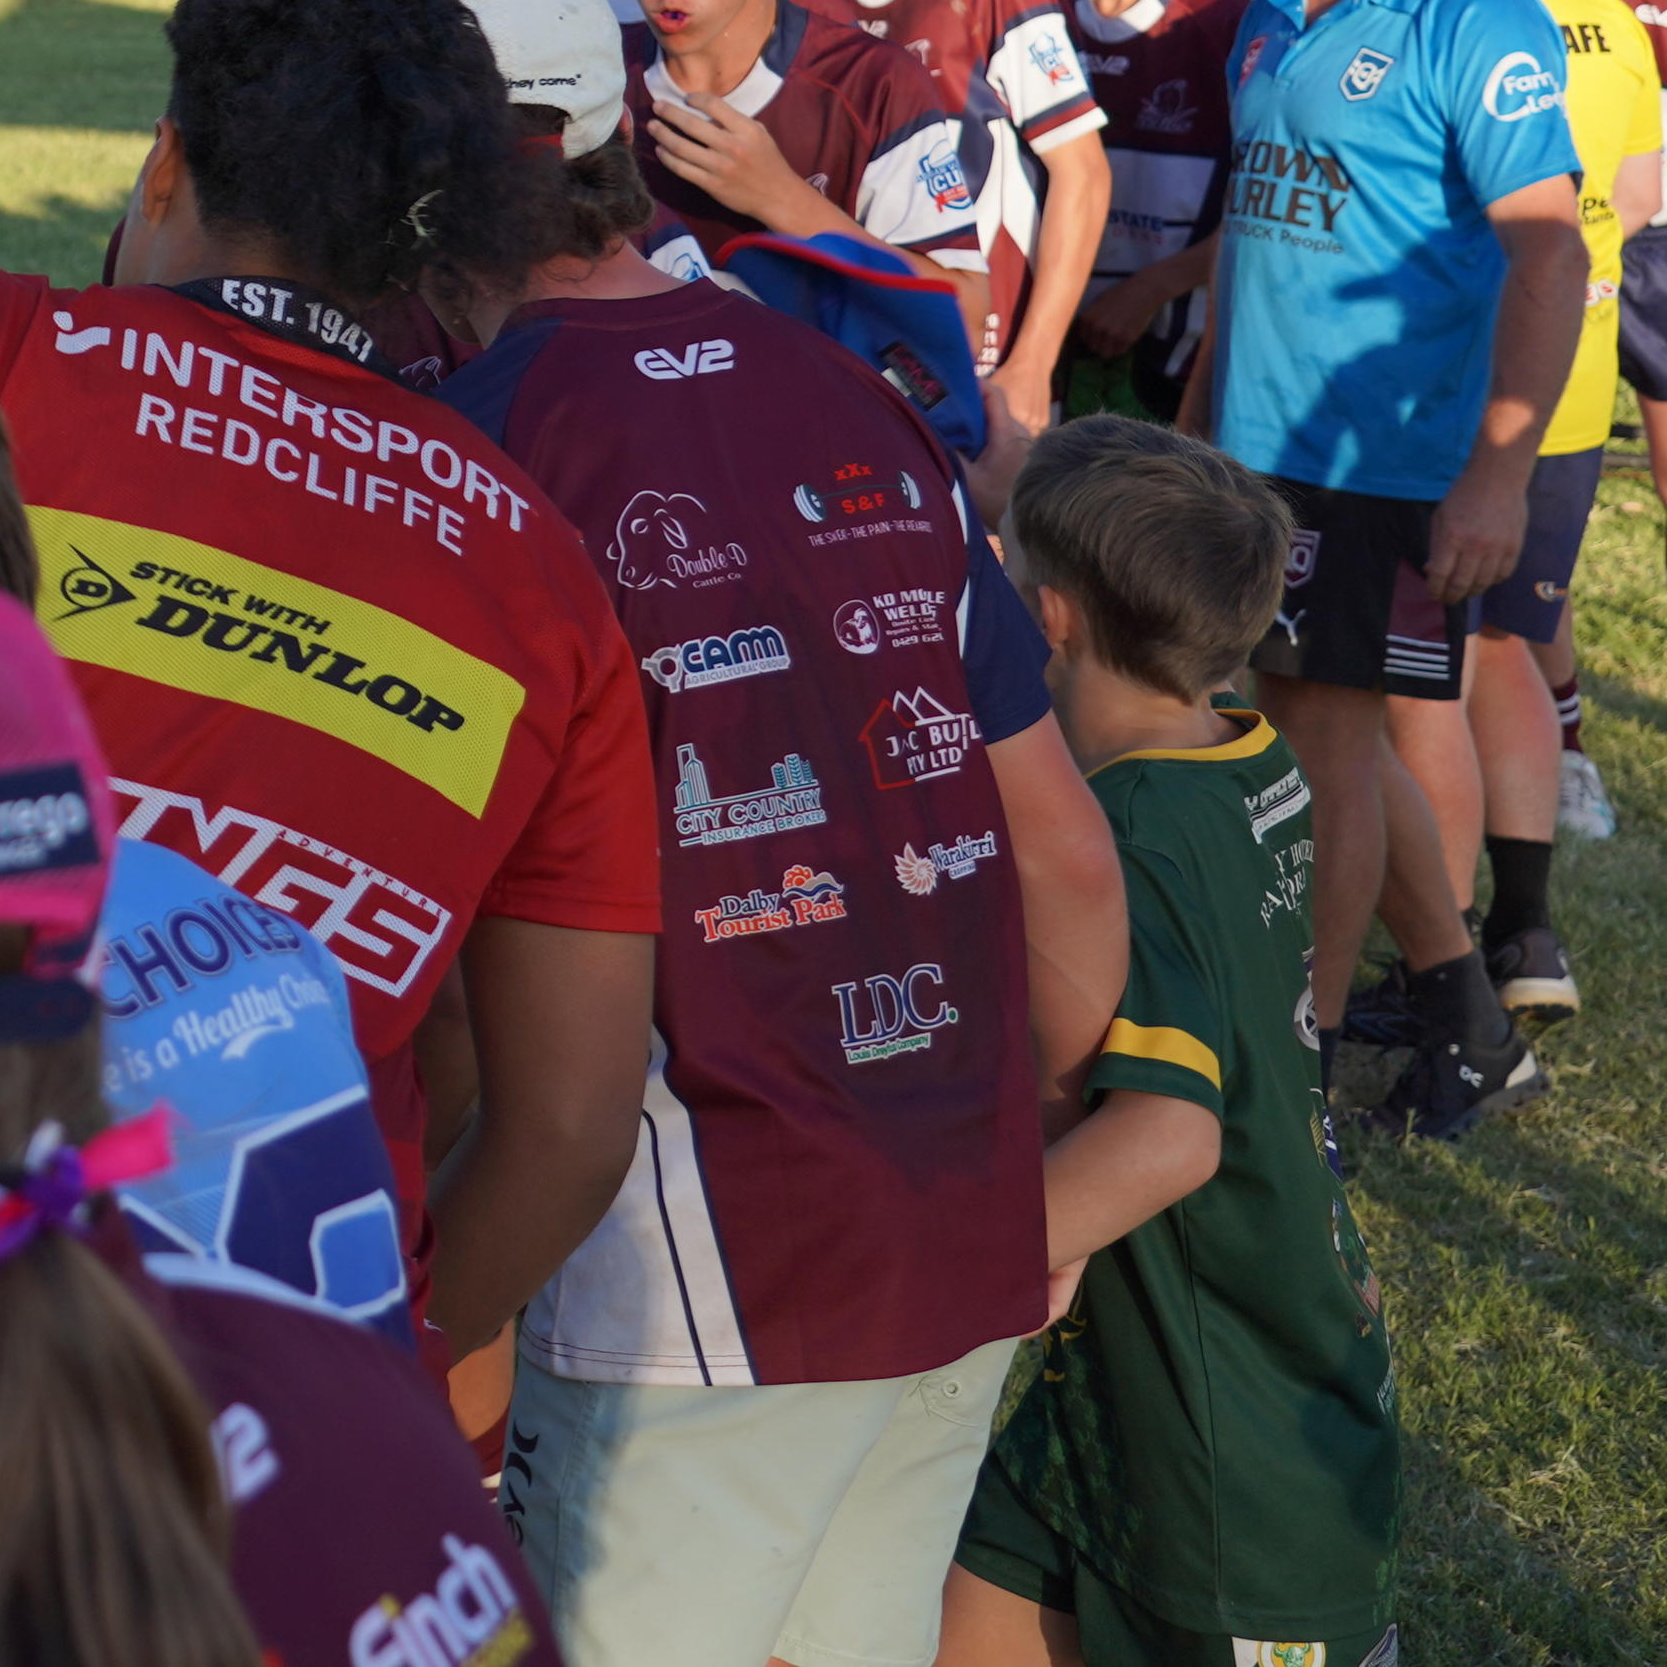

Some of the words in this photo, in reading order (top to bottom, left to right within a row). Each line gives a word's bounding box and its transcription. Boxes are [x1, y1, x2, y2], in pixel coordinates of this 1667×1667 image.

[507, 77, 535, 91] hey
[1278, 229, 1347, 255] People
[220, 277, 295, 325] EST.
[121, 327, 530, 533] INTERSPORT
[134, 392, 466, 557] REDCLIFFE
[667, 546, 729, 578] Double
[726, 542, 748, 566] D
[129, 561, 239, 606] STICK
[242, 593, 331, 635] WITH
[872, 593, 896, 608] KD
[134, 593, 465, 733] DUNLOP
[685, 663, 758, 687] AGRICULTURAL
[758, 657, 790, 671] GROUP
[929, 746, 963, 768] LTD
[676, 807, 723, 835] CITY
[727, 787, 822, 825] COUNTRY
[702, 820, 774, 845] INSURANCE
[777, 808, 827, 832] BROKERS
[278, 827, 447, 920] ADVENTURE
[695, 905, 793, 943] Tourist
[790, 892, 847, 926] Park
[720, 888, 780, 918] Dalby
[173, 984, 295, 1058] Healthy
